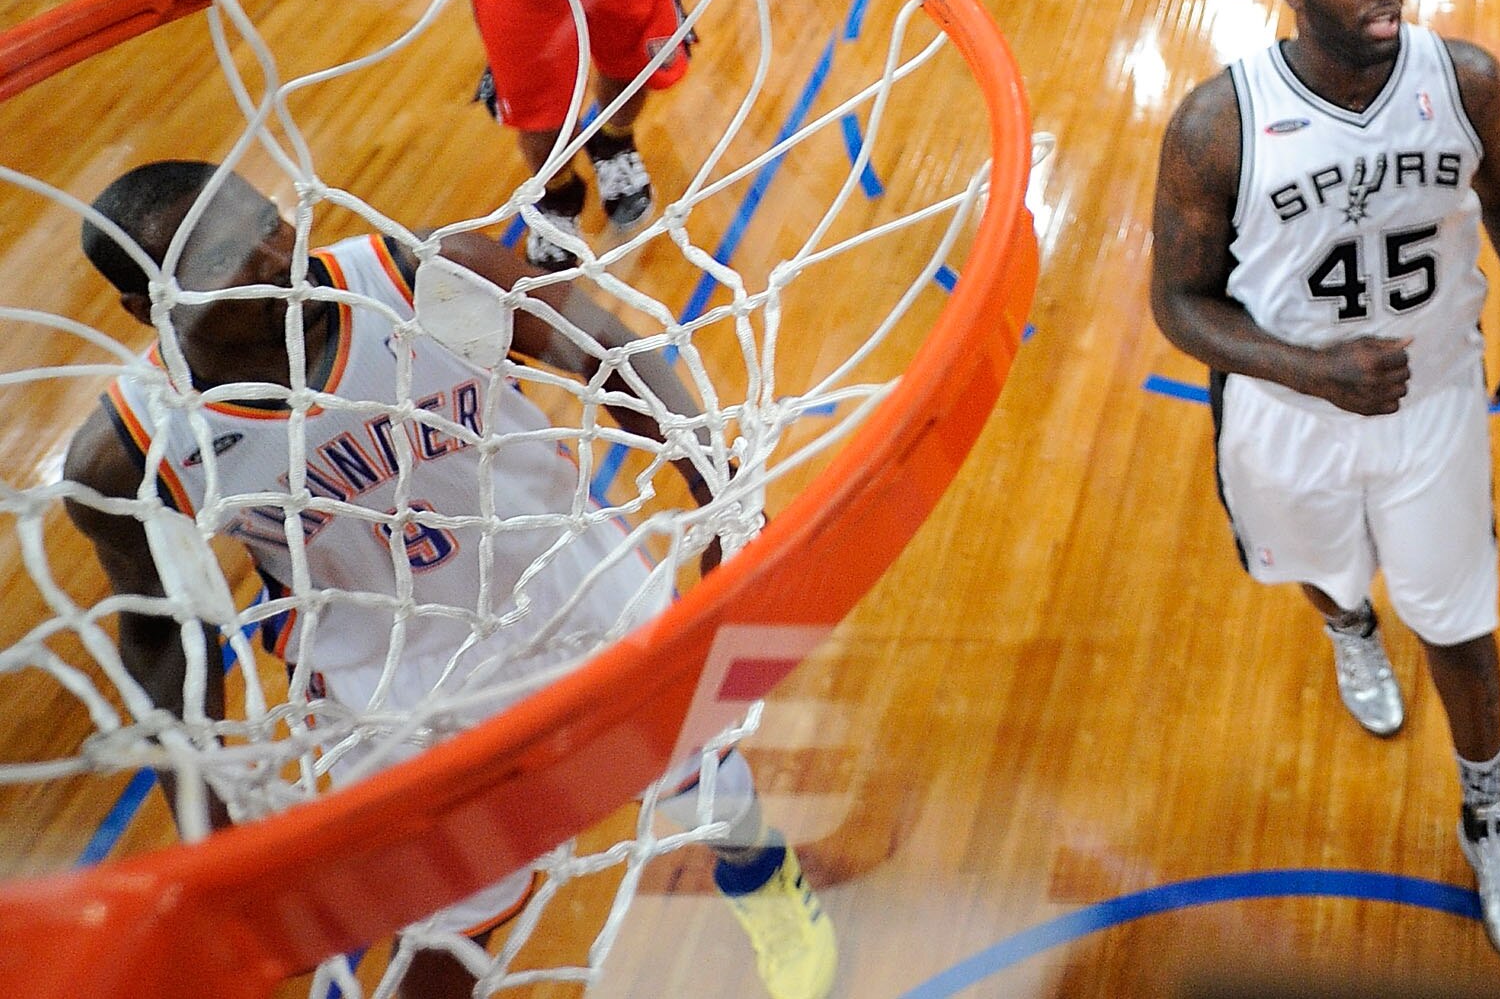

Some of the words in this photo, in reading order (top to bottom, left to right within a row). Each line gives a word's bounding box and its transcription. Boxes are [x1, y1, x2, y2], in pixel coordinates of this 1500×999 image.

[1269, 152, 1462, 224] SPURS
[1305, 217, 1442, 323] 45
[374, 500, 460, 575] 9
